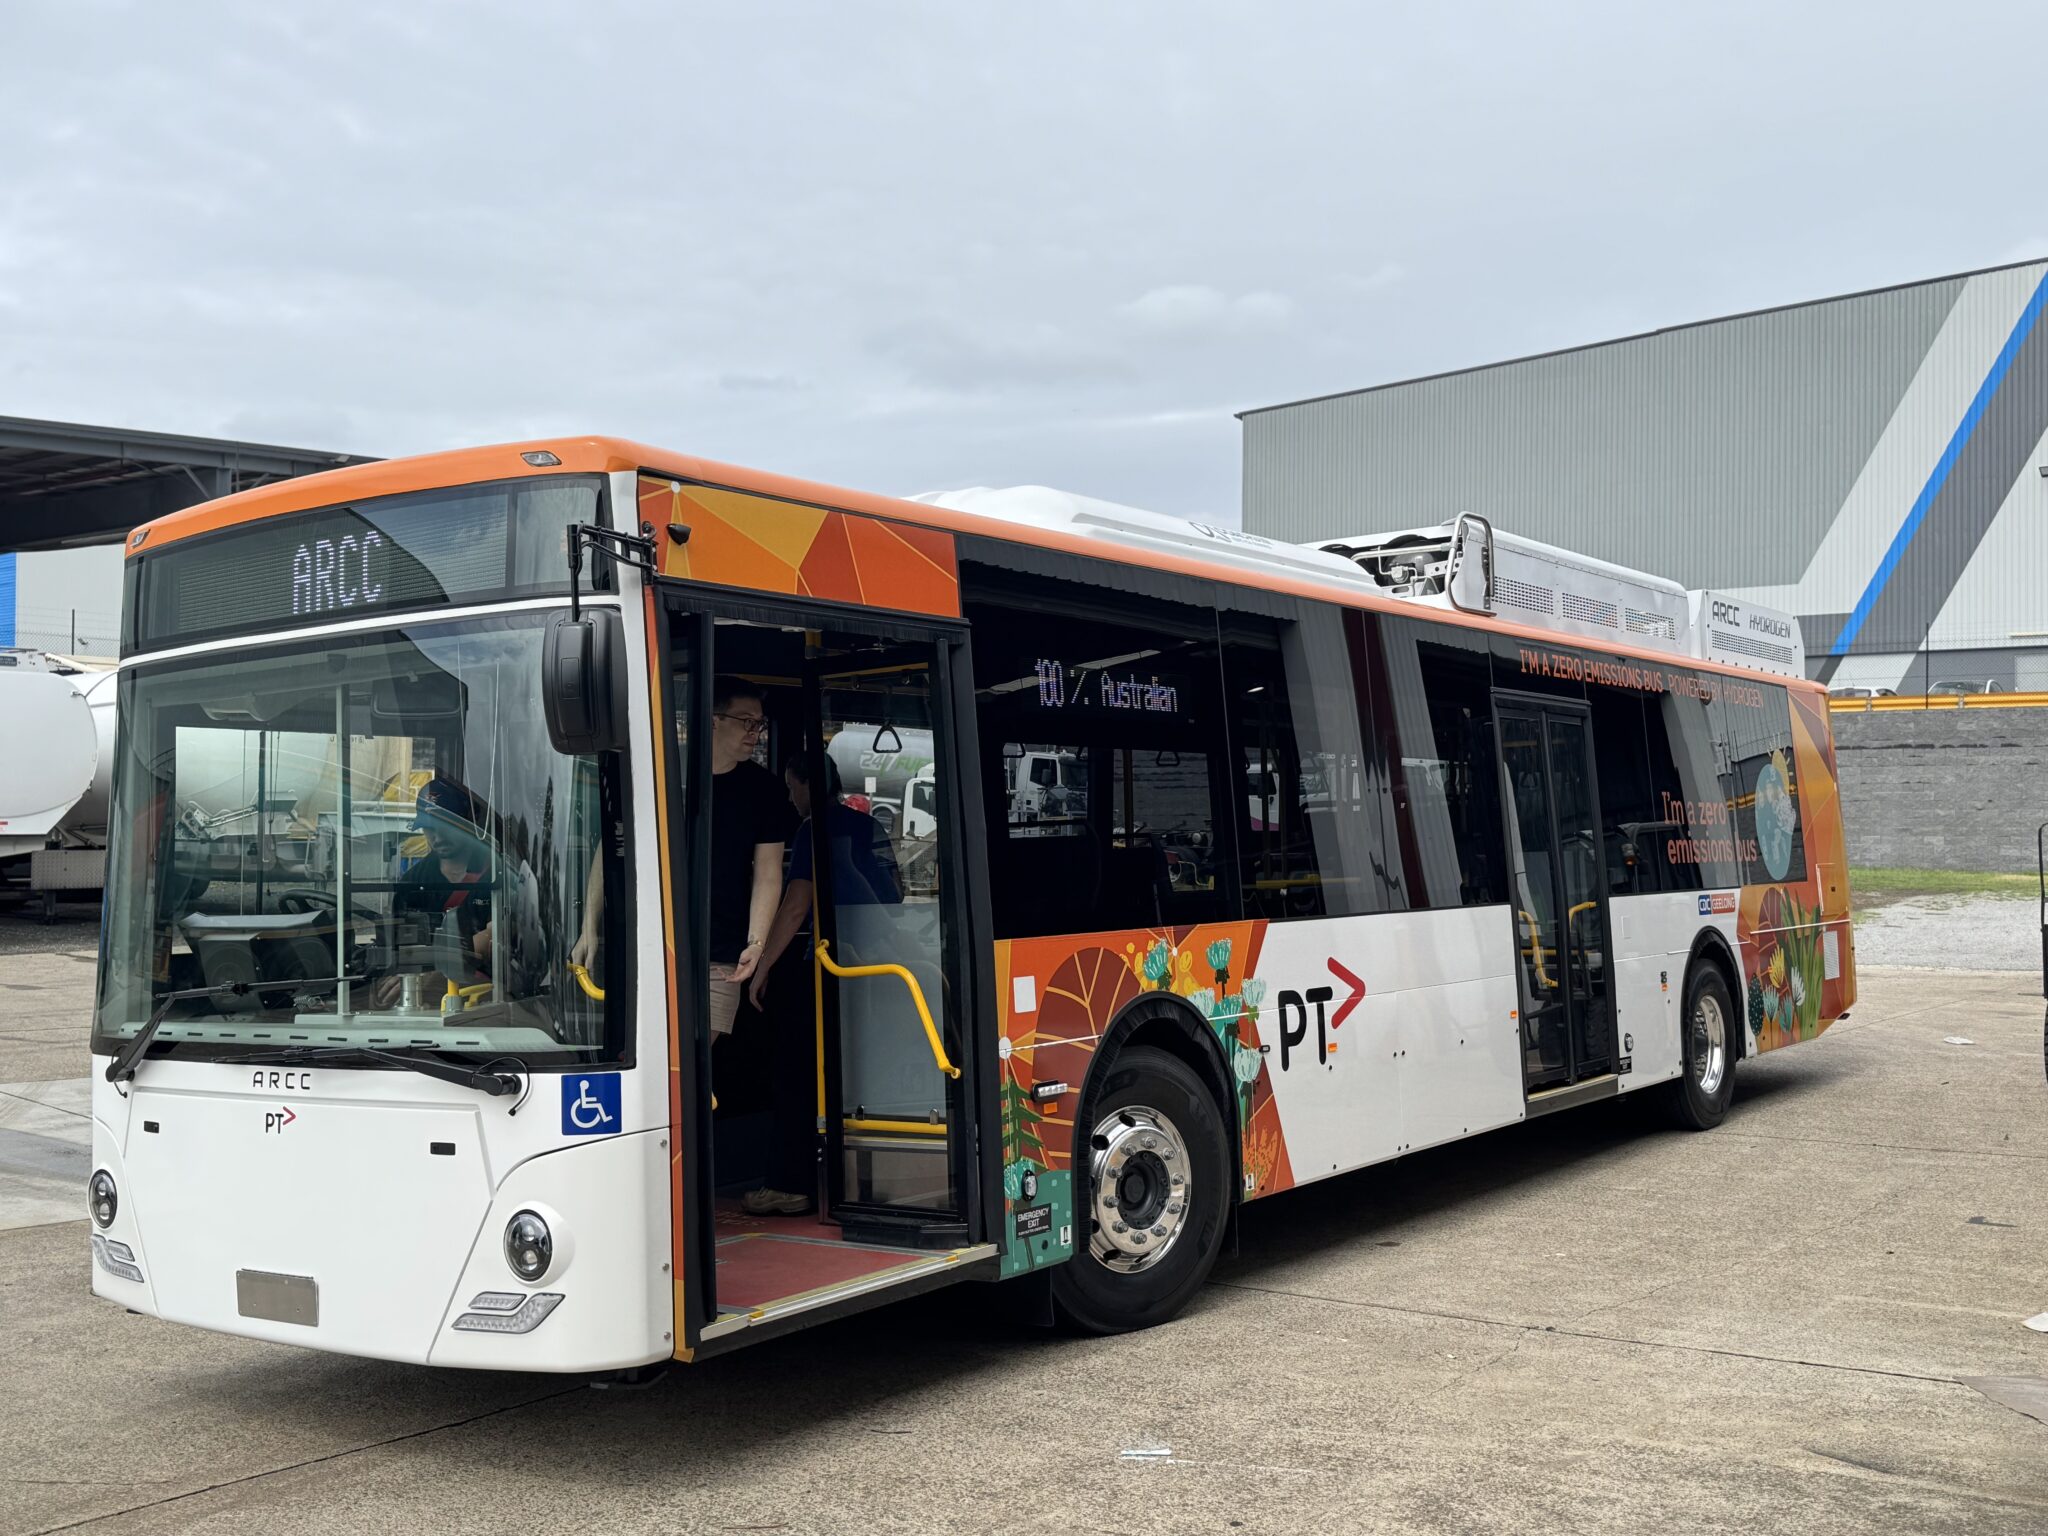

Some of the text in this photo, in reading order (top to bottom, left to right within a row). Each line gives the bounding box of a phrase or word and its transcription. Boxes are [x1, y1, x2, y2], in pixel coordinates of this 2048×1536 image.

[293, 531, 381, 614] ARCC
[1712, 600, 1791, 639] ARCC HYDROGEN
[1034, 658, 1064, 708] 100
[1101, 670, 1178, 713] Australian
[1519, 649, 1764, 708] I'M A ZERO EMISSIONS BUS POWERED BY HYDROGEN
[1661, 791, 1727, 826] I'm a zero
[1667, 831, 1758, 864] emissions bus
[1277, 986, 1333, 1072] PT
[252, 1070, 311, 1090] ARCC
[265, 1112, 285, 1135] PT
[1017, 1207, 1050, 1223] EMERGENCY
[1027, 1218, 1040, 1229] EXIT
